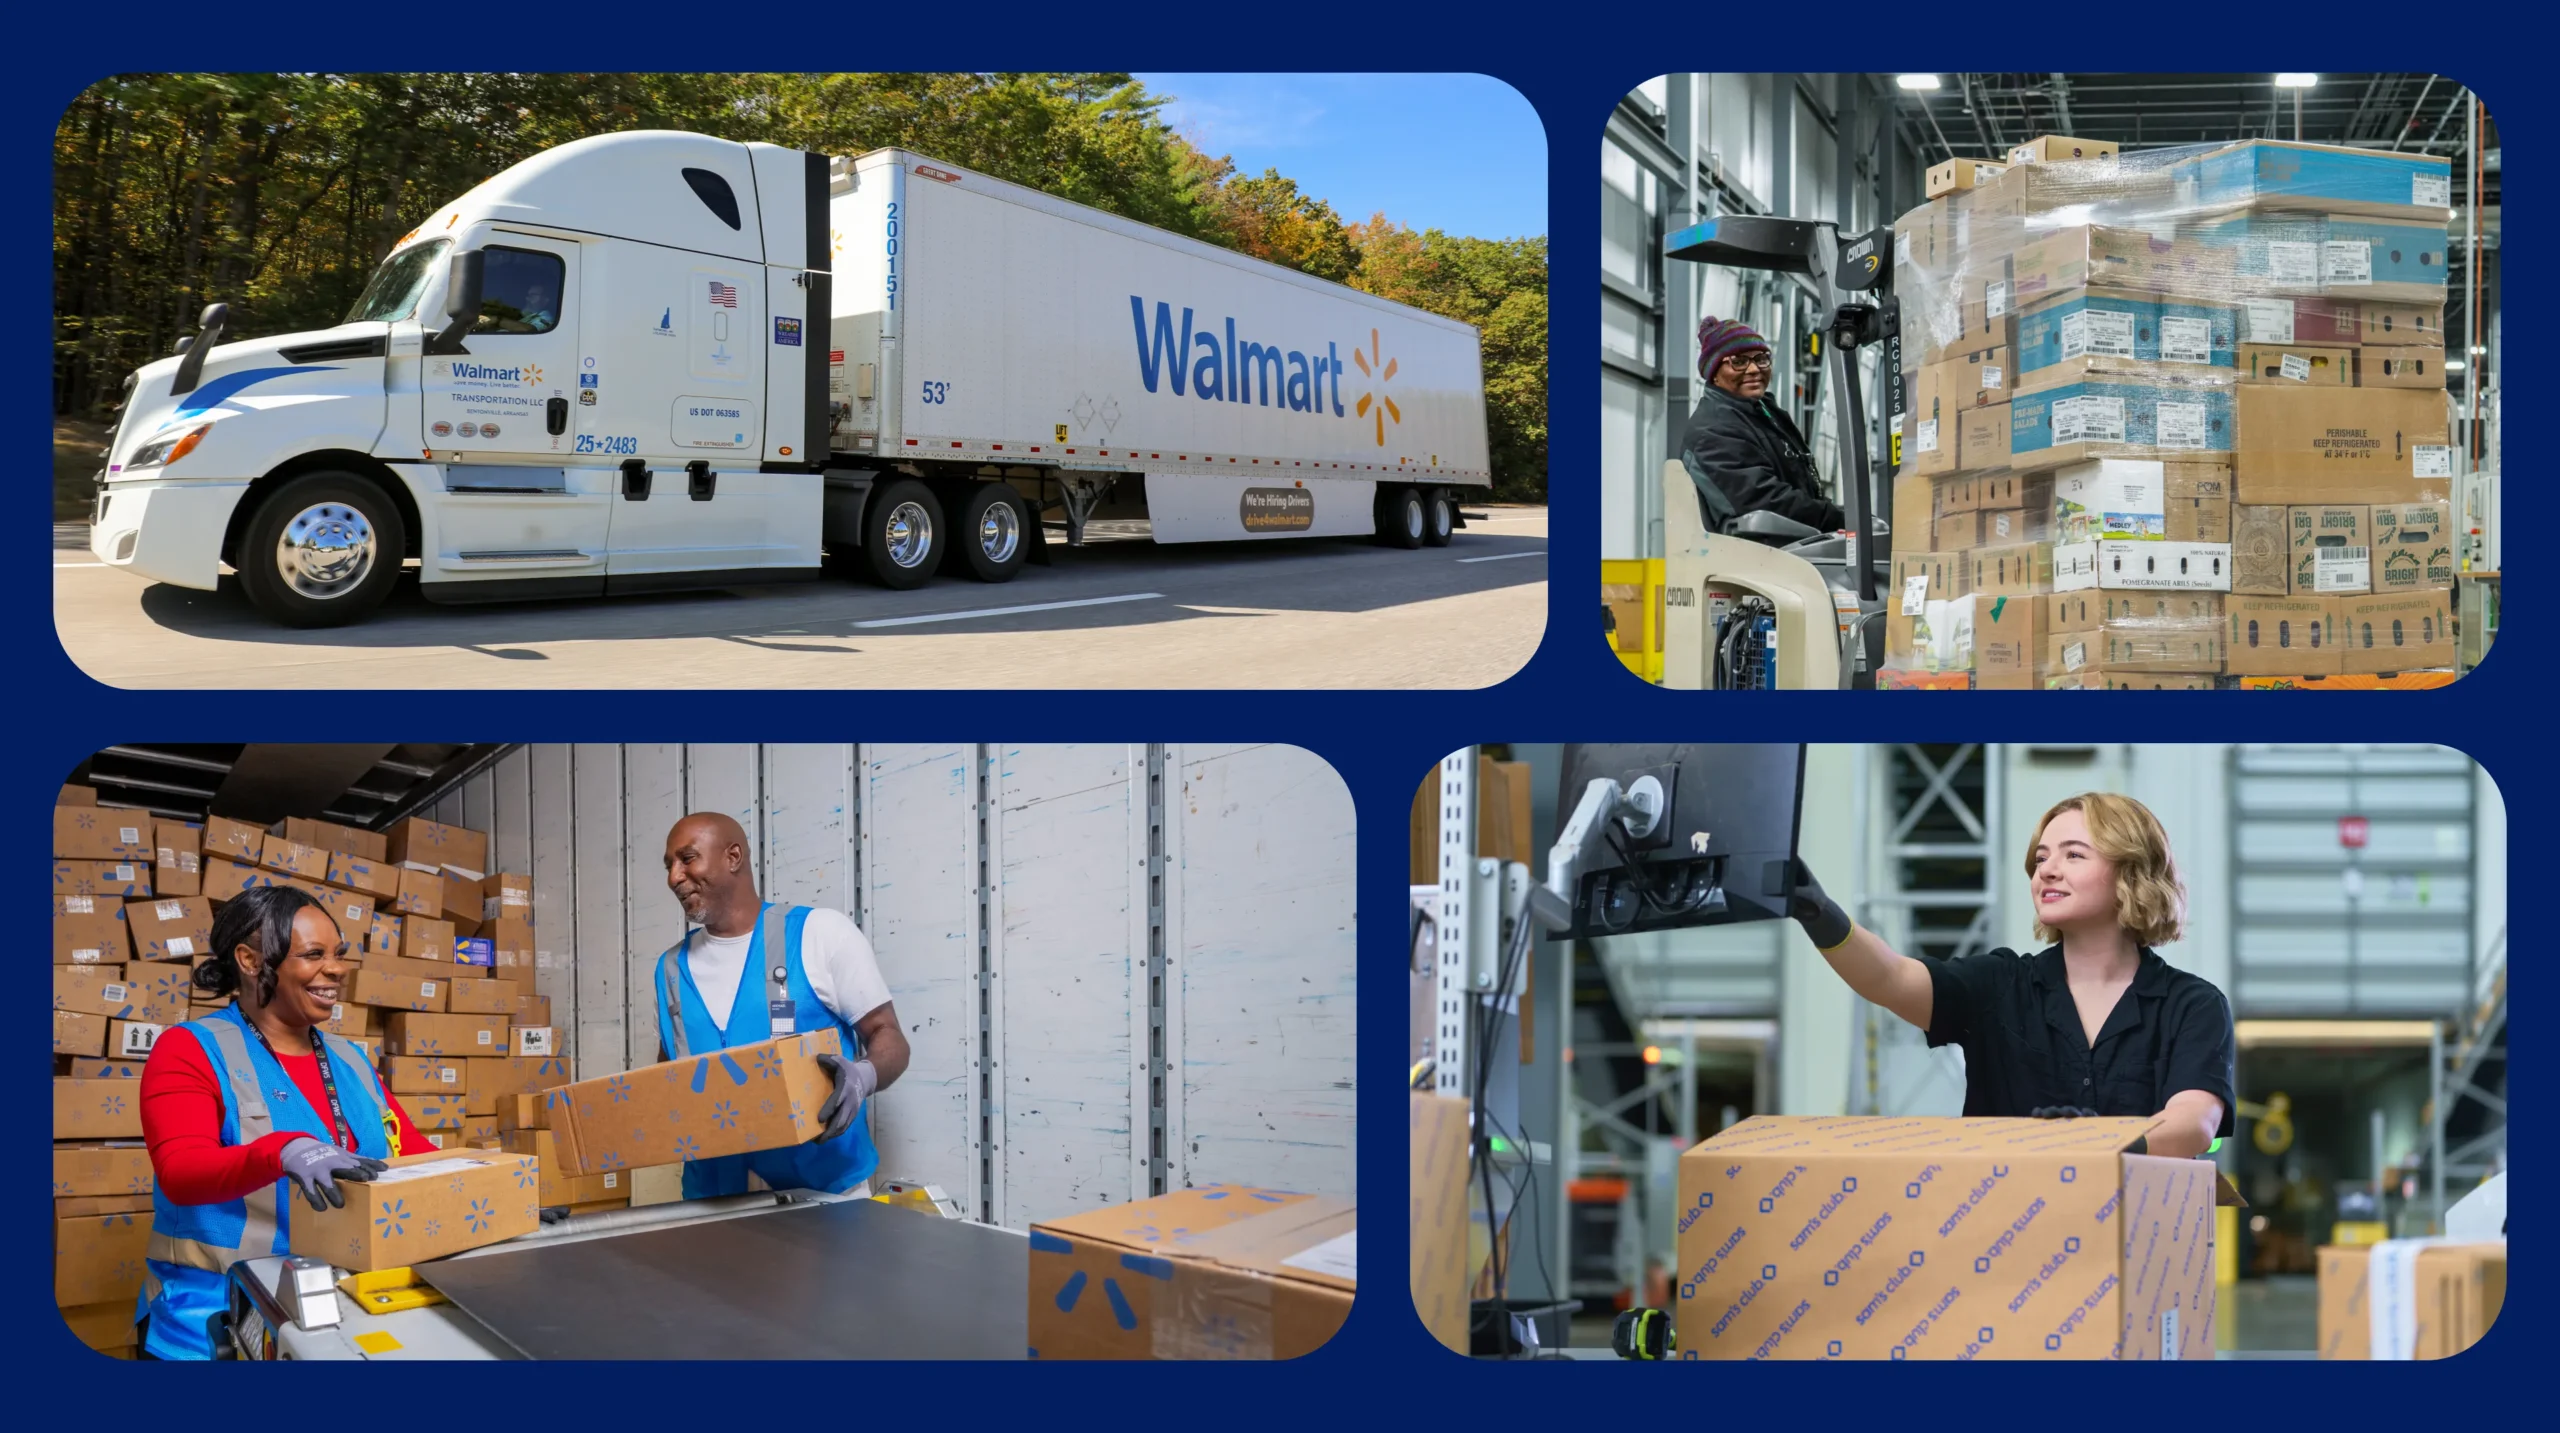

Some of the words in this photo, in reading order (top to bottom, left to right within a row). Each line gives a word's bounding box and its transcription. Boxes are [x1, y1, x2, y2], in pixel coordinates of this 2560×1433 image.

[886, 202, 898, 310] 200151
[1847, 238, 1874, 263] CROWN
[1130, 295, 1345, 418] Walmart
[452, 362, 520, 381] Walmart
[452, 393, 528, 406] TRANSPORTATION
[529, 398, 544, 406] LLC
[690, 408, 699, 416] US
[701, 408, 714, 417] DOT
[1056, 424, 1067, 435] LIFT
[2326, 429, 2367, 438] PERISHABLE
[2313, 439, 2331, 448] KEEP
[2332, 439, 2380, 449] REFRIGERATED
[2324, 450, 2333, 459] AT
[1246, 493, 1265, 507] We're
[1266, 494, 1287, 510] Hiring
[1288, 494, 1310, 507] Drivers
[1245, 513, 1310, 527] drive4walmart.com
[2109, 520, 2132, 530] MEDLEY
[2320, 516, 2356, 528] BRIGHT
[2405, 512, 2439, 525] BRIGHT
[2121, 578, 2172, 587] POMEGRANATE
[2173, 580, 2190, 588] ARILS
[2191, 581, 2212, 589] (Seeds)
[2385, 568, 2420, 581] BRIGHT
[1666, 586, 1695, 608] CROWN
[2243, 602, 2261, 611] KEEP
[2264, 602, 2320, 612] REFRIGERATED
[2356, 605, 2375, 614] KEEP
[2376, 600, 2431, 612] REFRIGERATED
[320, 1062, 331, 1080] DFWS
[330, 1099, 341, 1117] DFWS
[1939, 1203, 1971, 1238] sam's
[1969, 1176, 1997, 1206] club
[2012, 1196, 2047, 1232] sam's
[1789, 1217, 1822, 1251] sam's
[1819, 1192, 1846, 1221] club
[1859, 1212, 1893, 1247] sam's
[1715, 1226, 1747, 1260] sam's
[1988, 1229, 2016, 1259] club
[1836, 1243, 1863, 1273] club
[1692, 1257, 1719, 1285] club
[2008, 1279, 2043, 1314] sam's
[2039, 1252, 2068, 1282] club
[1855, 1291, 1889, 1326] sam's
[1885, 1265, 1913, 1294] club
[1927, 1287, 1961, 1322] sam's
[2083, 1274, 2120, 1310] sam's
[1711, 1304, 1743, 1338] sam's
[1738, 1279, 1766, 1308] club
[1779, 1299, 1812, 1335] sam's
[2059, 1306, 2087, 1336] club
[1754, 1330, 1782, 1360] club
[1903, 1318, 1930, 1349] club
